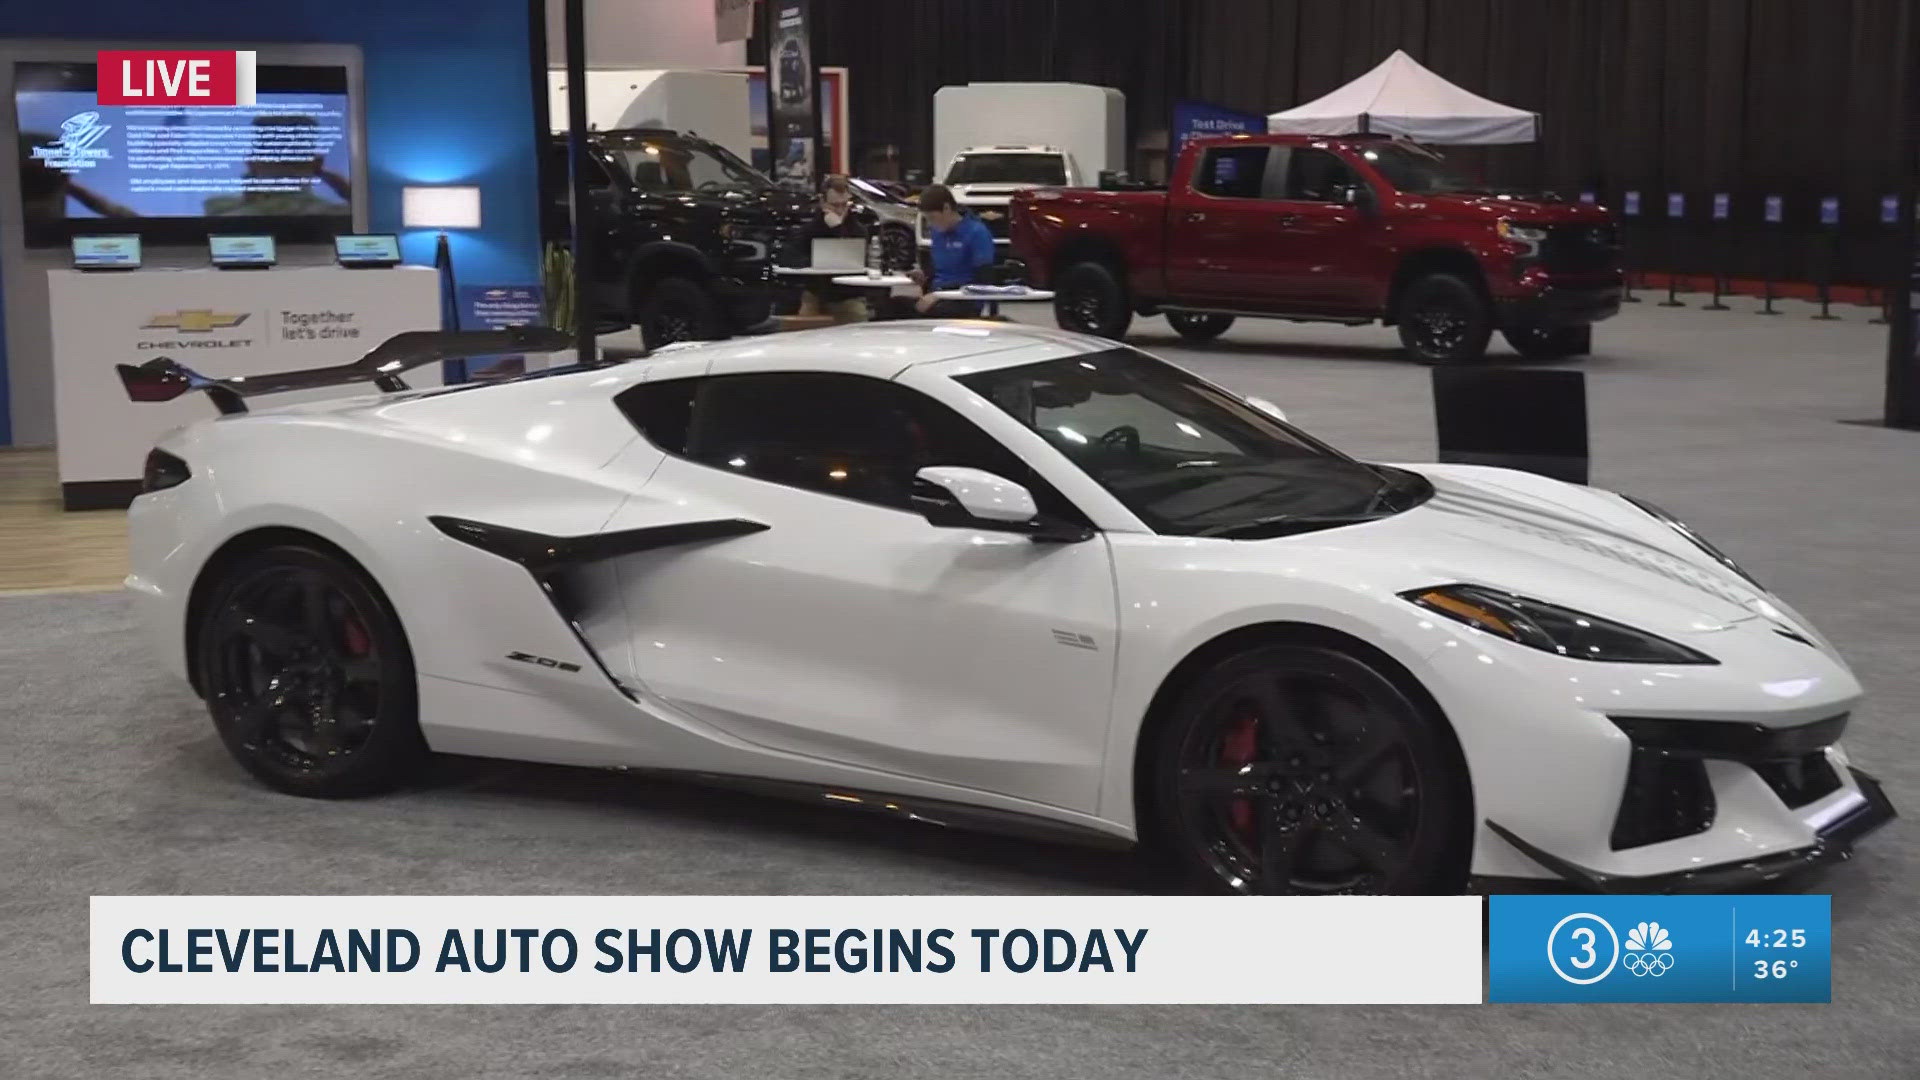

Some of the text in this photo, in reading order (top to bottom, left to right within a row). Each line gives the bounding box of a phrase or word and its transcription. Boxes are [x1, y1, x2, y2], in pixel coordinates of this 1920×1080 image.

[281, 311, 355, 325] Together
[281, 327, 360, 340] let's drive
[137, 339, 253, 350] CHEVROLET
